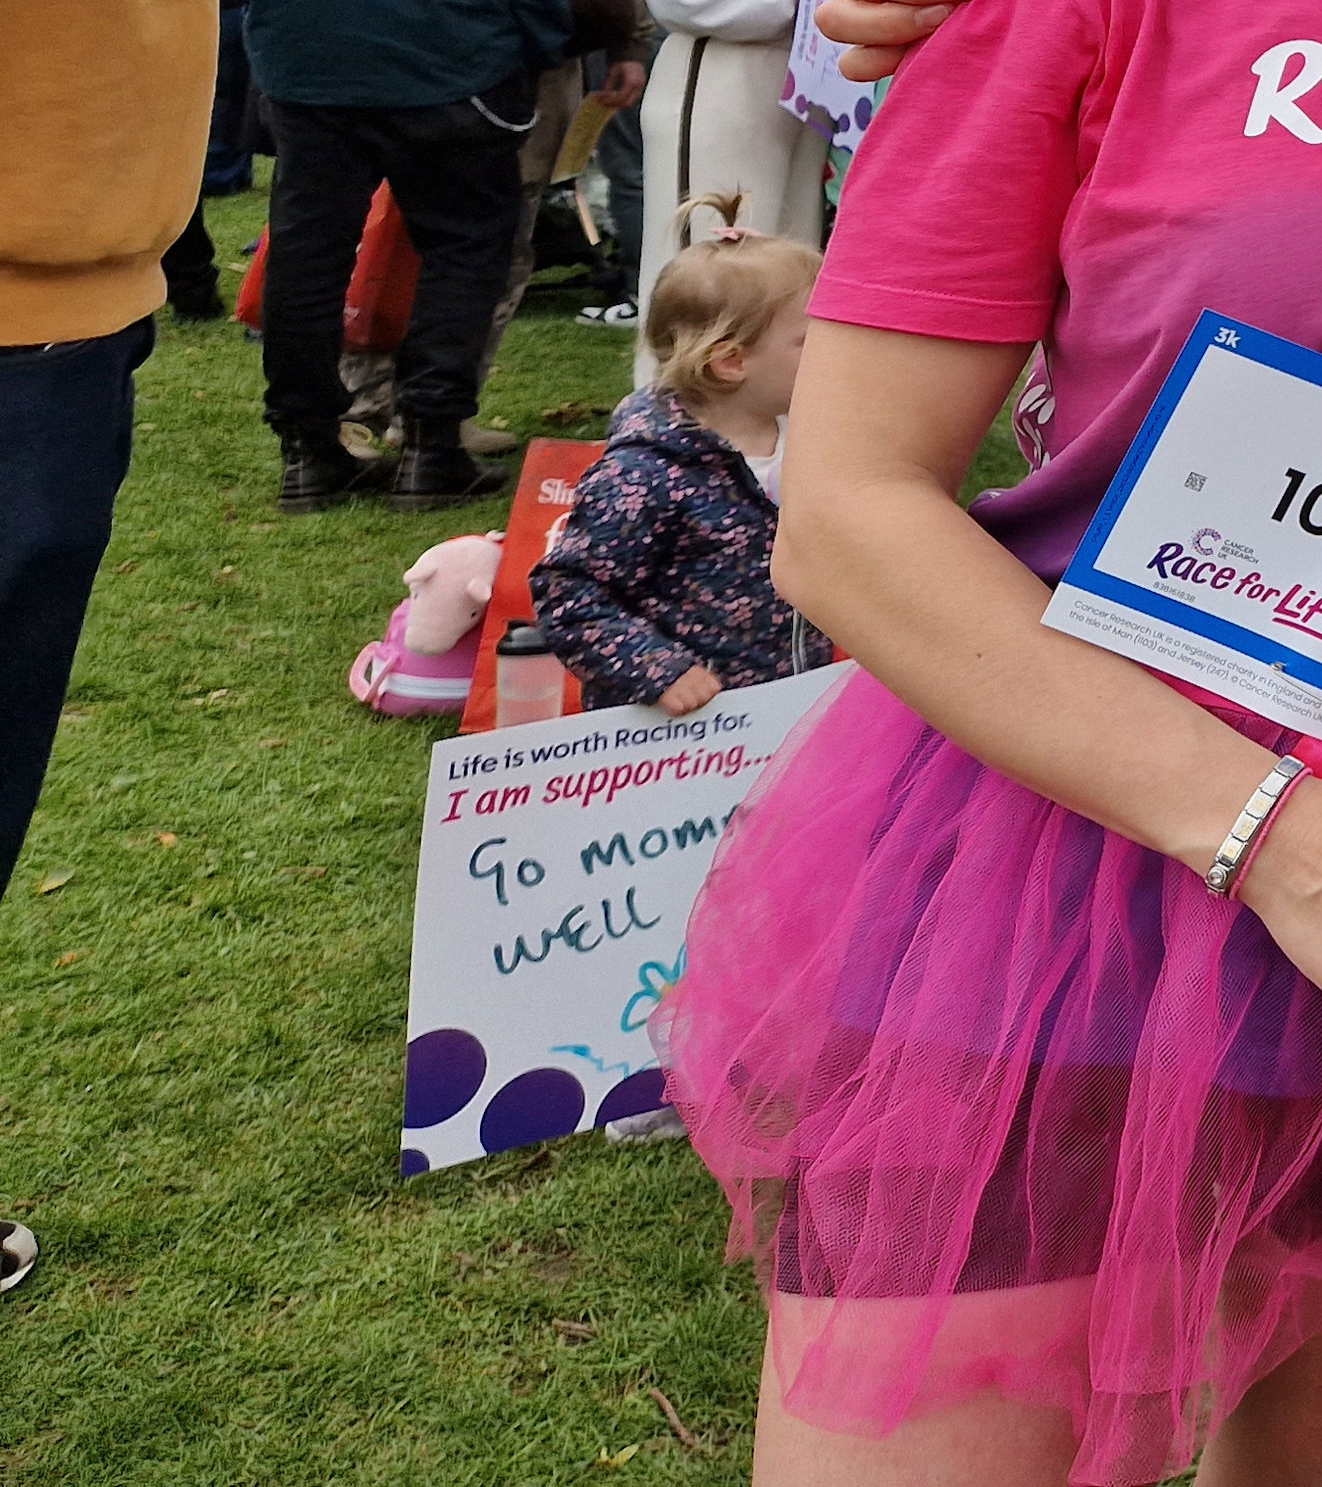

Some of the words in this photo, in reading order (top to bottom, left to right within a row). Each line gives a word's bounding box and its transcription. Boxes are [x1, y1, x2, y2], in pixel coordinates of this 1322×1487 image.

[1213, 326, 1241, 349] 3k
[1147, 543, 1235, 589] Race
[1234, 572, 1280, 612] for
[1220, 543, 1259, 566] RESEARCH
[1223, 537, 1255, 556] CANCER
[448, 757, 498, 782] Life
[503, 748, 524, 770] is
[530, 732, 609, 765] worth
[614, 717, 708, 750] Racing
[440, 788, 470, 825] I
[474, 783, 531, 816] am
[542, 744, 774, 809] supporting...
[468, 837, 546, 906] Go
